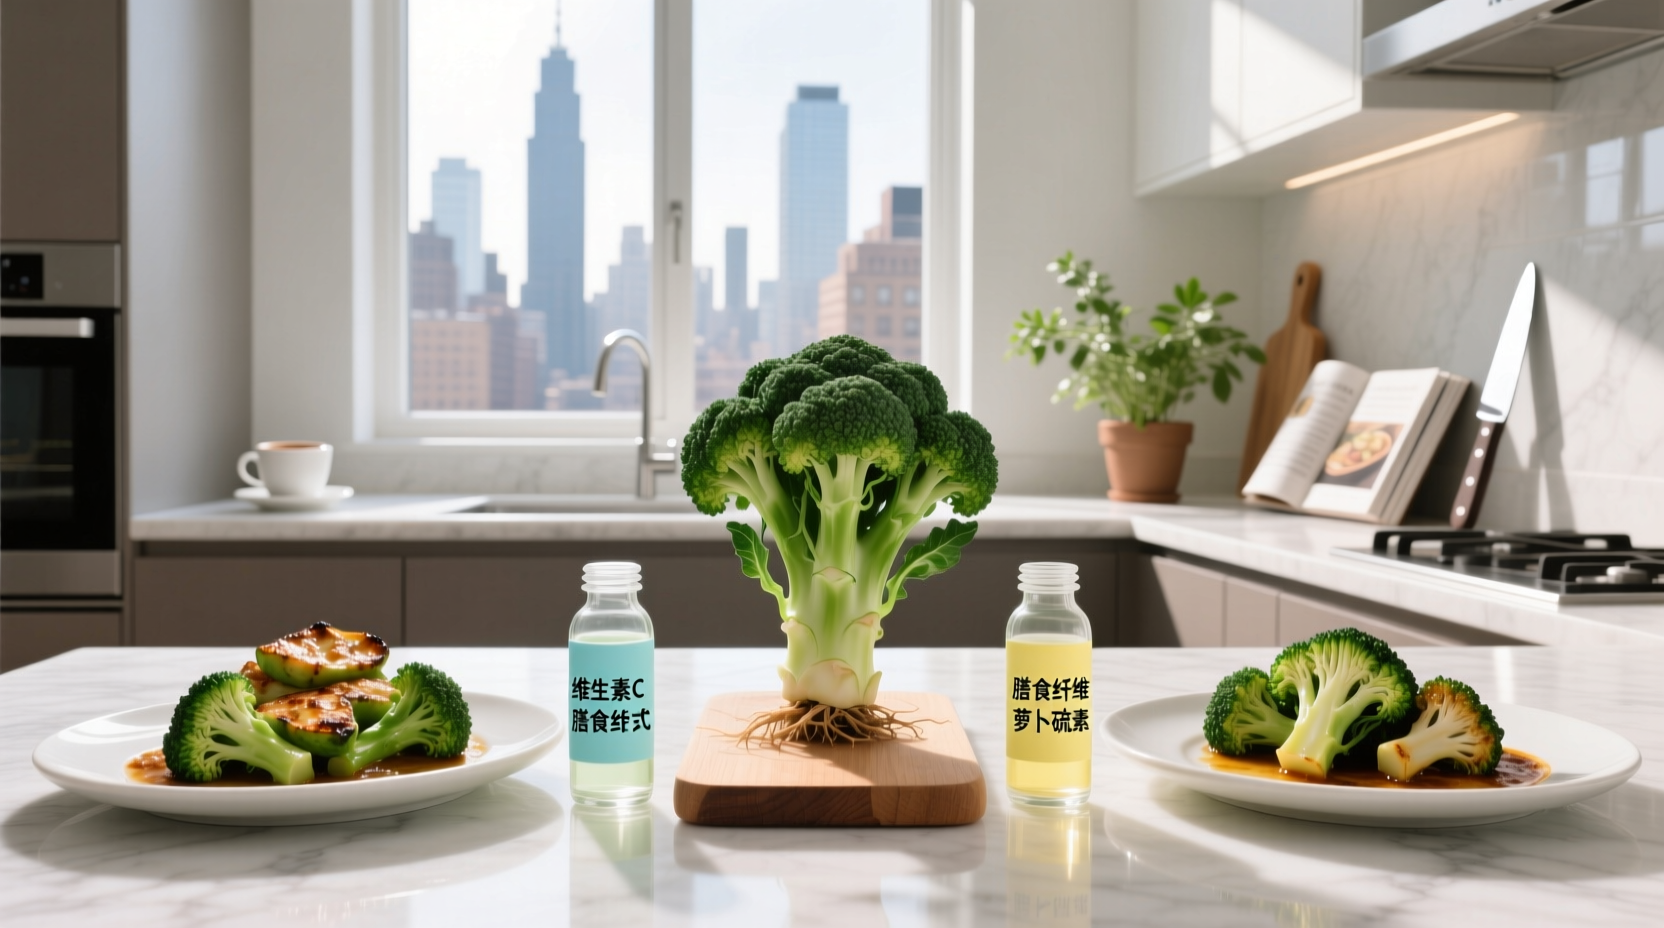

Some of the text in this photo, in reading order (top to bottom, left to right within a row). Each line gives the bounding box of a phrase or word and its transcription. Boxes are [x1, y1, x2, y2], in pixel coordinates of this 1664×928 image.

[571, 676, 645, 702] 维生素C
[1012, 676, 1090, 702] 膳食纤维
[1012, 707, 1090, 734] 萝卜硫素
